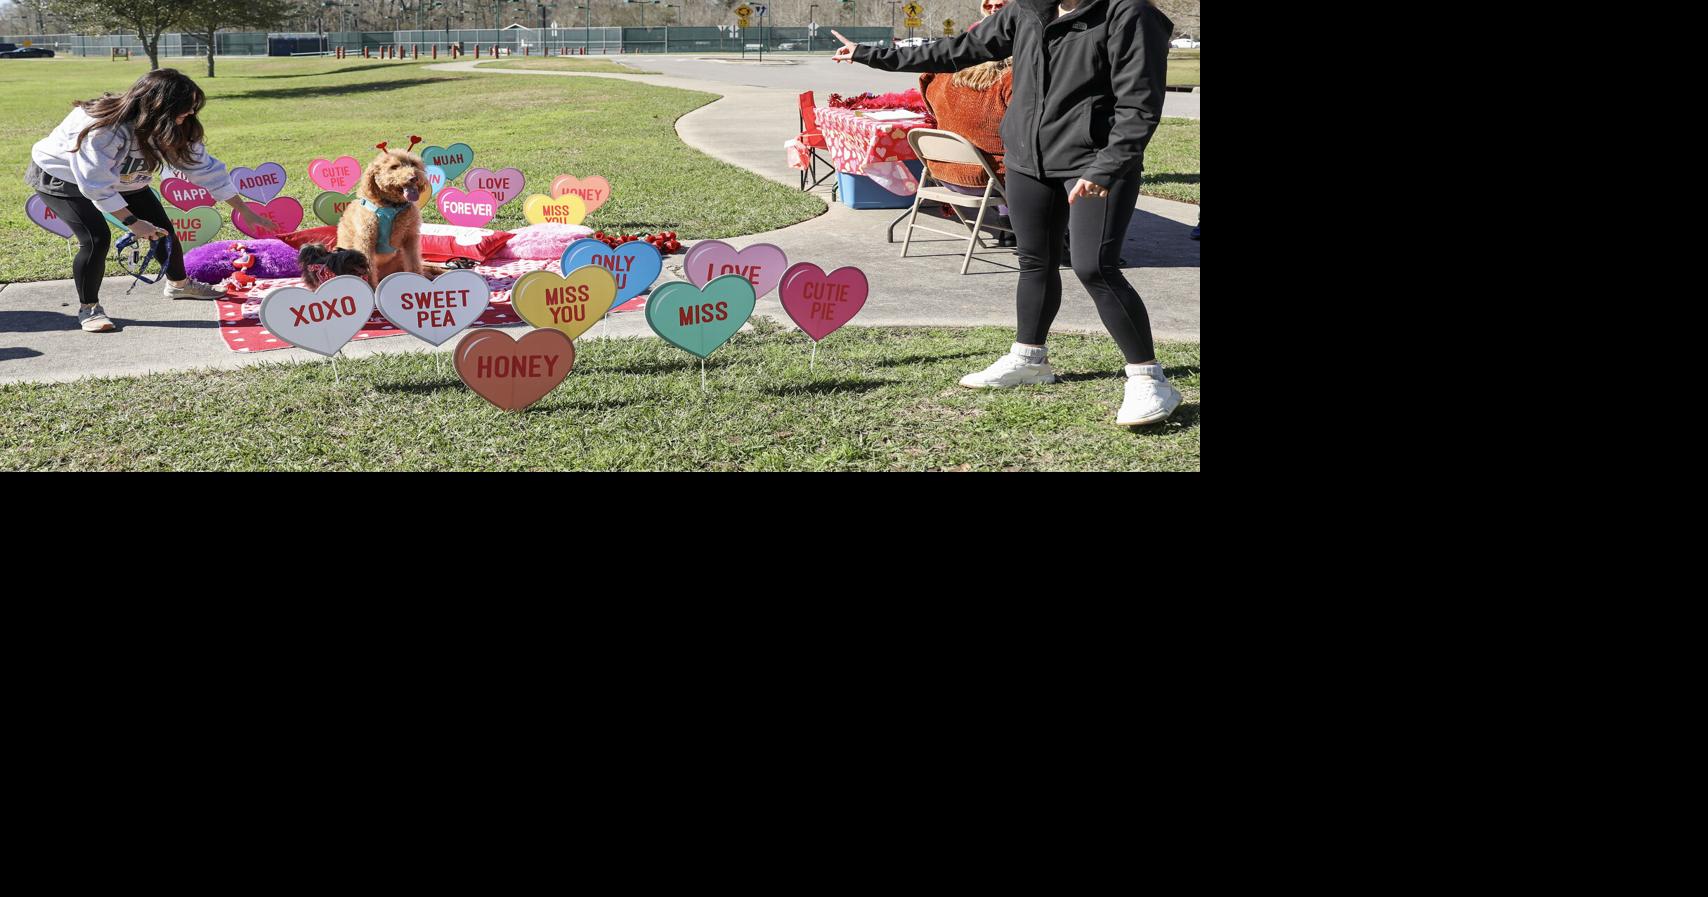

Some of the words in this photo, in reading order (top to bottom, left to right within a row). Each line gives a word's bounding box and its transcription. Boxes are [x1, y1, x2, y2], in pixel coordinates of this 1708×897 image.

[432, 153, 464, 166] MUAH
[321, 165, 351, 178] CUTIE
[239, 172, 279, 190] ADORE
[330, 177, 345, 187] PIE
[478, 177, 510, 190] LOVE
[334, 201, 352, 213] KI
[443, 201, 493, 217] FOREVER
[542, 205, 570, 217] MISS
[171, 218, 202, 229] HUG
[176, 231, 197, 242] ME
[401, 289, 470, 310] SWEET
[545, 284, 590, 306] MISS
[802, 281, 850, 303] CUTIE
[289, 295, 357, 328] XOXO
[417, 310, 456, 329] PEA
[549, 304, 586, 325] YOU
[678, 301, 728, 327] MISS
[810, 302, 836, 321] PIE
[476, 354, 560, 379] HONEY
